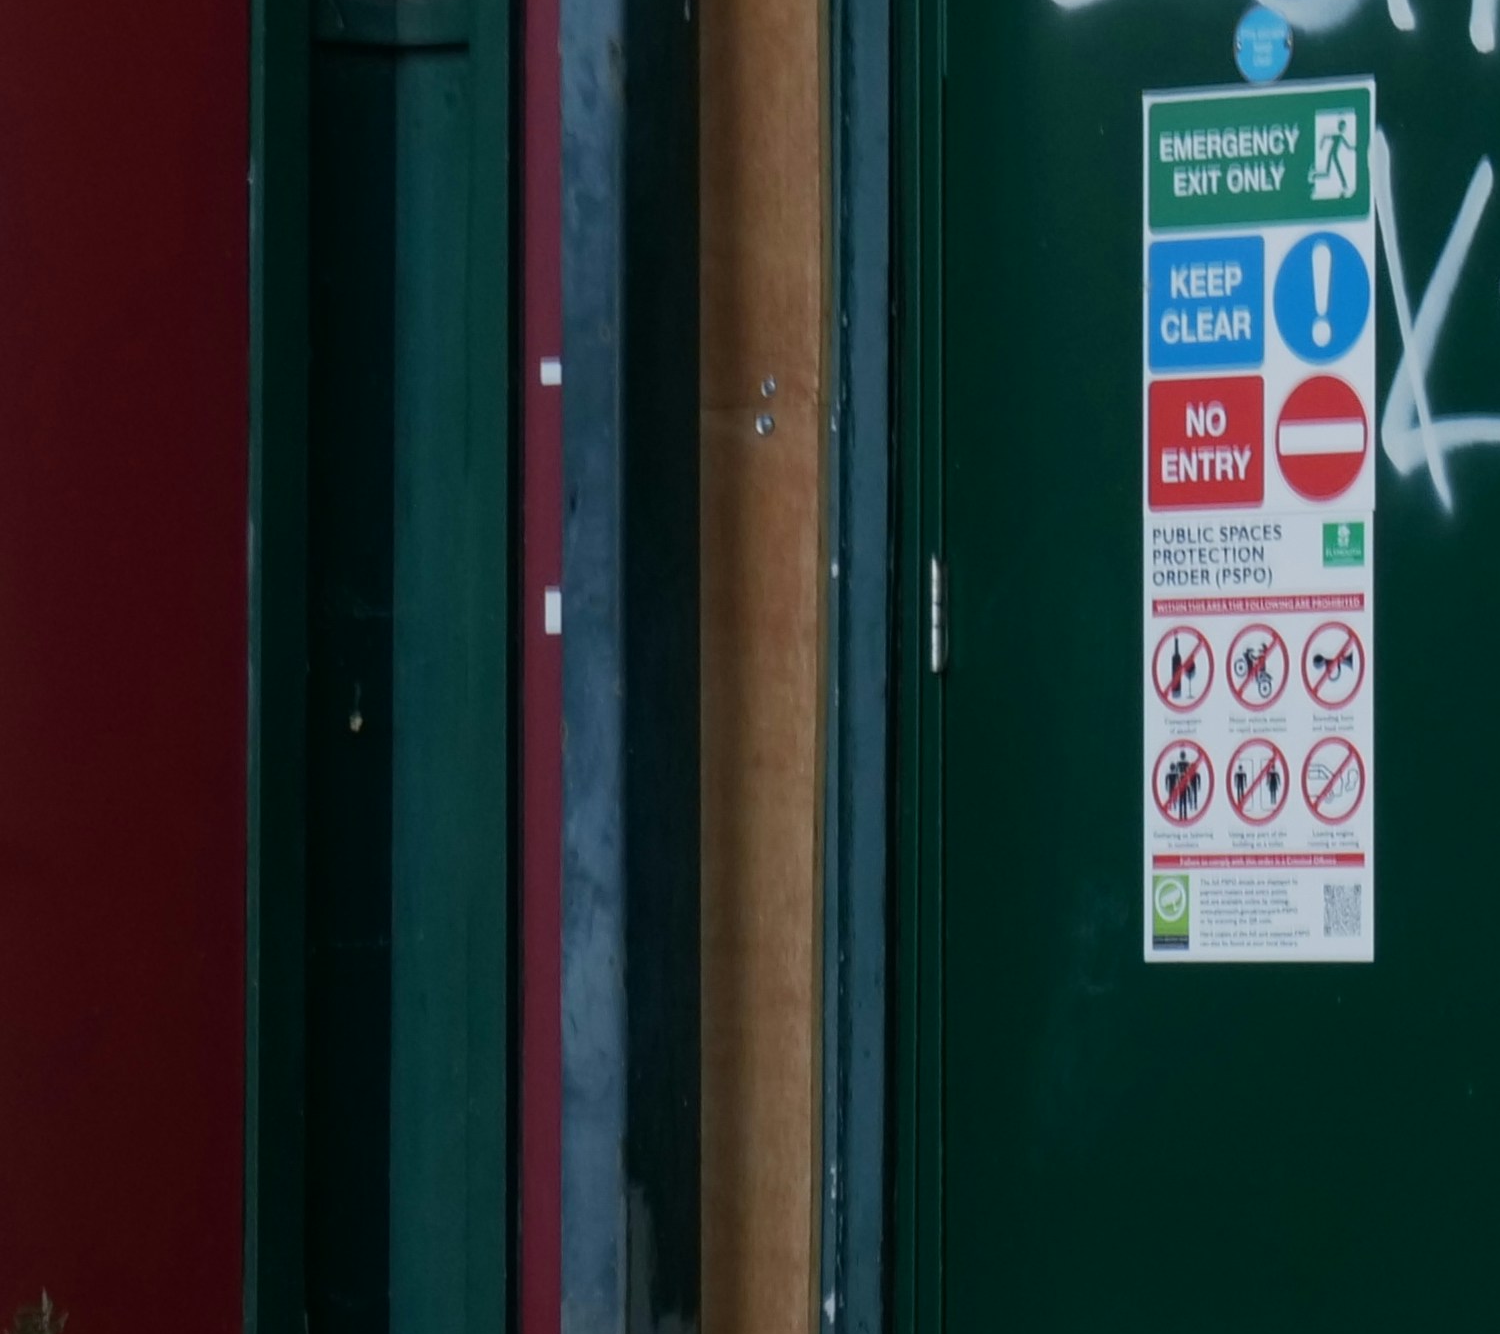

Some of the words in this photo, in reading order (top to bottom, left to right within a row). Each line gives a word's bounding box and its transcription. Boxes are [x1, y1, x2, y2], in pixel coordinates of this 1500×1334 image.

[1159, 123, 1301, 163] EMERGENCY
[1173, 165, 1222, 197] EXIT
[1227, 161, 1285, 192] ONLY
[1171, 262, 1242, 298] KEEP
[1160, 307, 1251, 344] CLEAR
[1185, 402, 1227, 438] NO
[1161, 445, 1251, 483] ENTRY
[1152, 527, 1214, 545] PUBLIC
[1220, 525, 1282, 543] SPACES
[1152, 546, 1265, 565] PROTECTION
[1152, 569, 1211, 586] ORDER
[1216, 567, 1273, 589] (PSPO)
